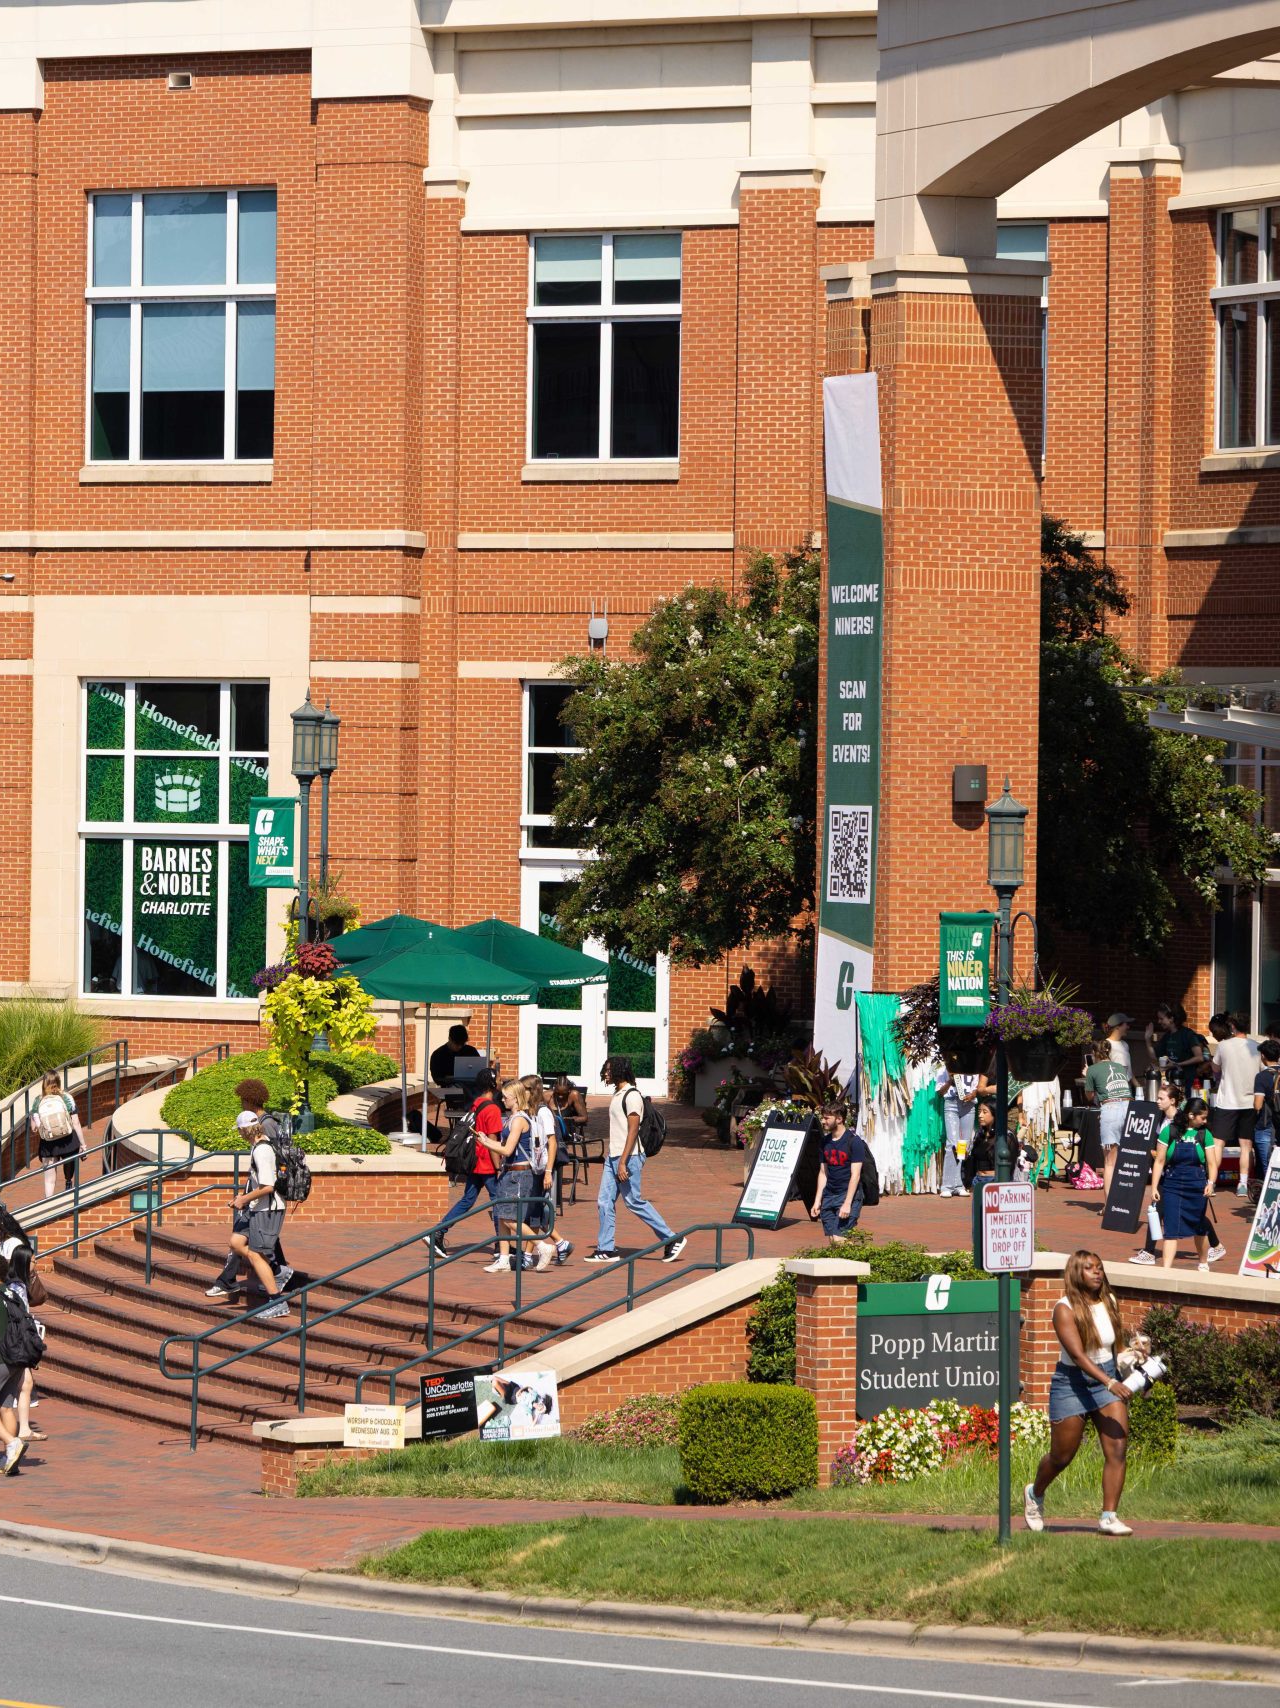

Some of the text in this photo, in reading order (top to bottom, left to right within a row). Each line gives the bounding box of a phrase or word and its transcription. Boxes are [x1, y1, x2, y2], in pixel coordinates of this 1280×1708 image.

[831, 583, 879, 604] WELCOME
[834, 616, 874, 636] NINERS!
[839, 680, 867, 699] SCAN
[139, 700, 220, 751] Homefield
[842, 712, 862, 731] FOR
[832, 744, 871, 763] EVENTS!
[258, 836, 285, 846] SHAPE
[257, 846, 289, 856] WHAT'S
[141, 846, 212, 874] BARNES
[255, 855, 278, 865] NEXT
[141, 901, 211, 916] CHARLOTTE
[136, 934, 217, 987] Homefield
[946, 950, 975, 962] THIS IS
[947, 960, 983, 977] NINER
[549, 974, 607, 986] STARBUCKS COFFEE
[948, 976, 984, 990] NATION
[765, 1138, 788, 1151] TOUR
[760, 1150, 786, 1163] GUIDE
[985, 1191, 1030, 1207] NO PARKING
[990, 1214, 1028, 1225] IMMEDIATE
[991, 1227, 1027, 1239] PICK UP &
[992, 1241, 1026, 1253] DROP OFF
[1000, 1255, 1019, 1266] ONLY
[870, 1334, 925, 1360] Popp
[425, 1376, 445, 1387] TEDx
[860, 1365, 999, 1390] Student Unio
[347, 1417, 369, 1425] WORSHIP
[374, 1418, 401, 1426] CHOCOLATE
[351, 1427, 379, 1435] WEDNESDAY
